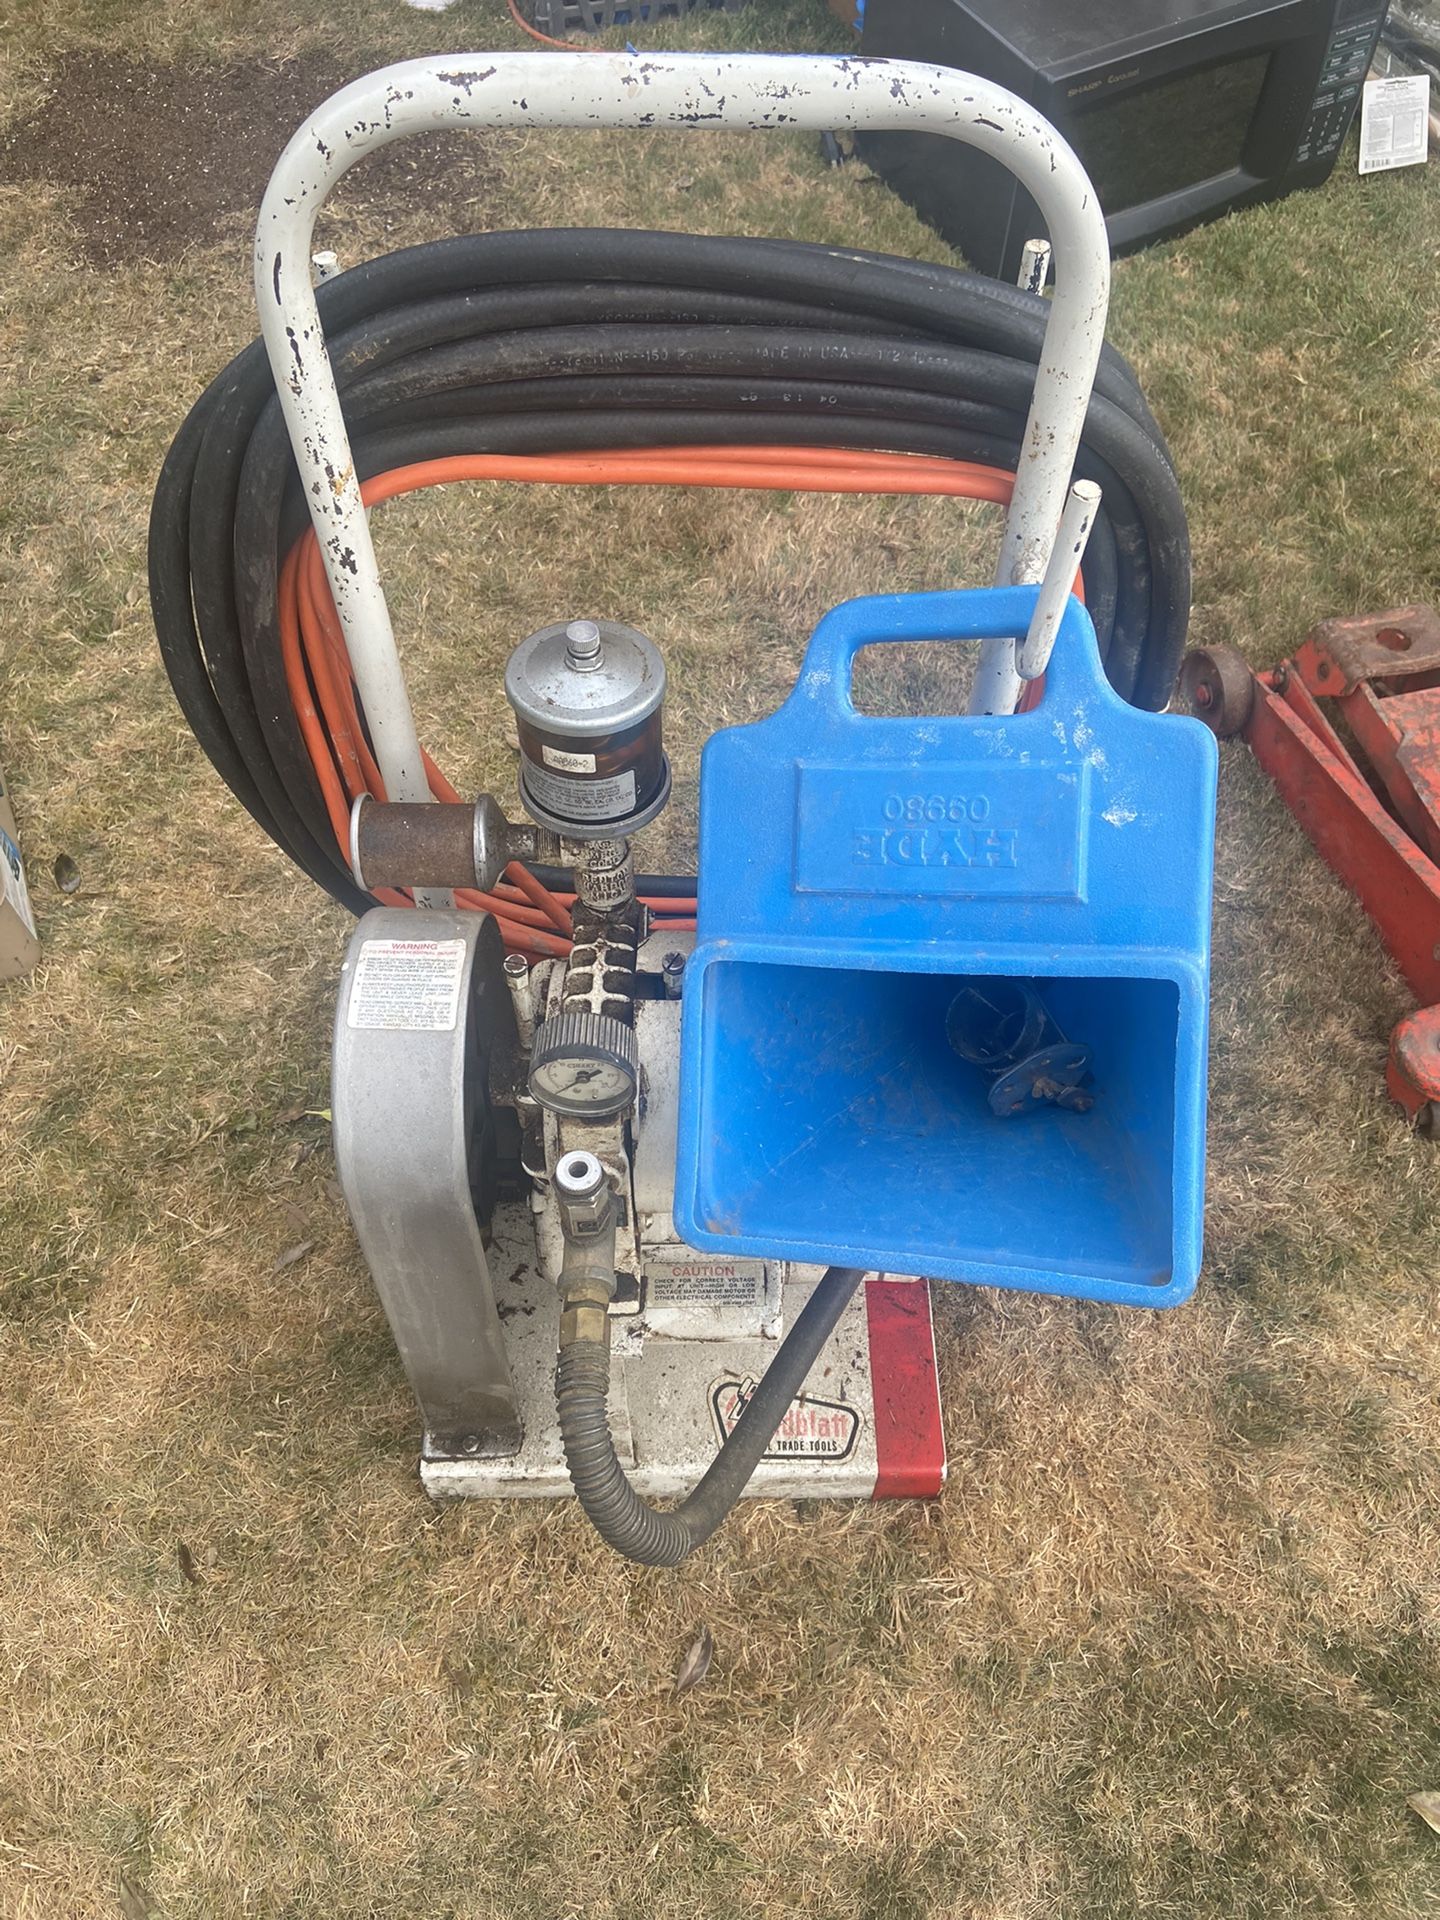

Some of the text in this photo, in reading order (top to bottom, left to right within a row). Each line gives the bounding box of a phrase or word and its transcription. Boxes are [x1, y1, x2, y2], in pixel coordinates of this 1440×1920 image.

[852, 828, 1018, 868] HYDE
[672, 1266, 735, 1276] CAUTION
[777, 1440, 804, 1450] TRADE
[809, 1440, 837, 1451] TOOLS
